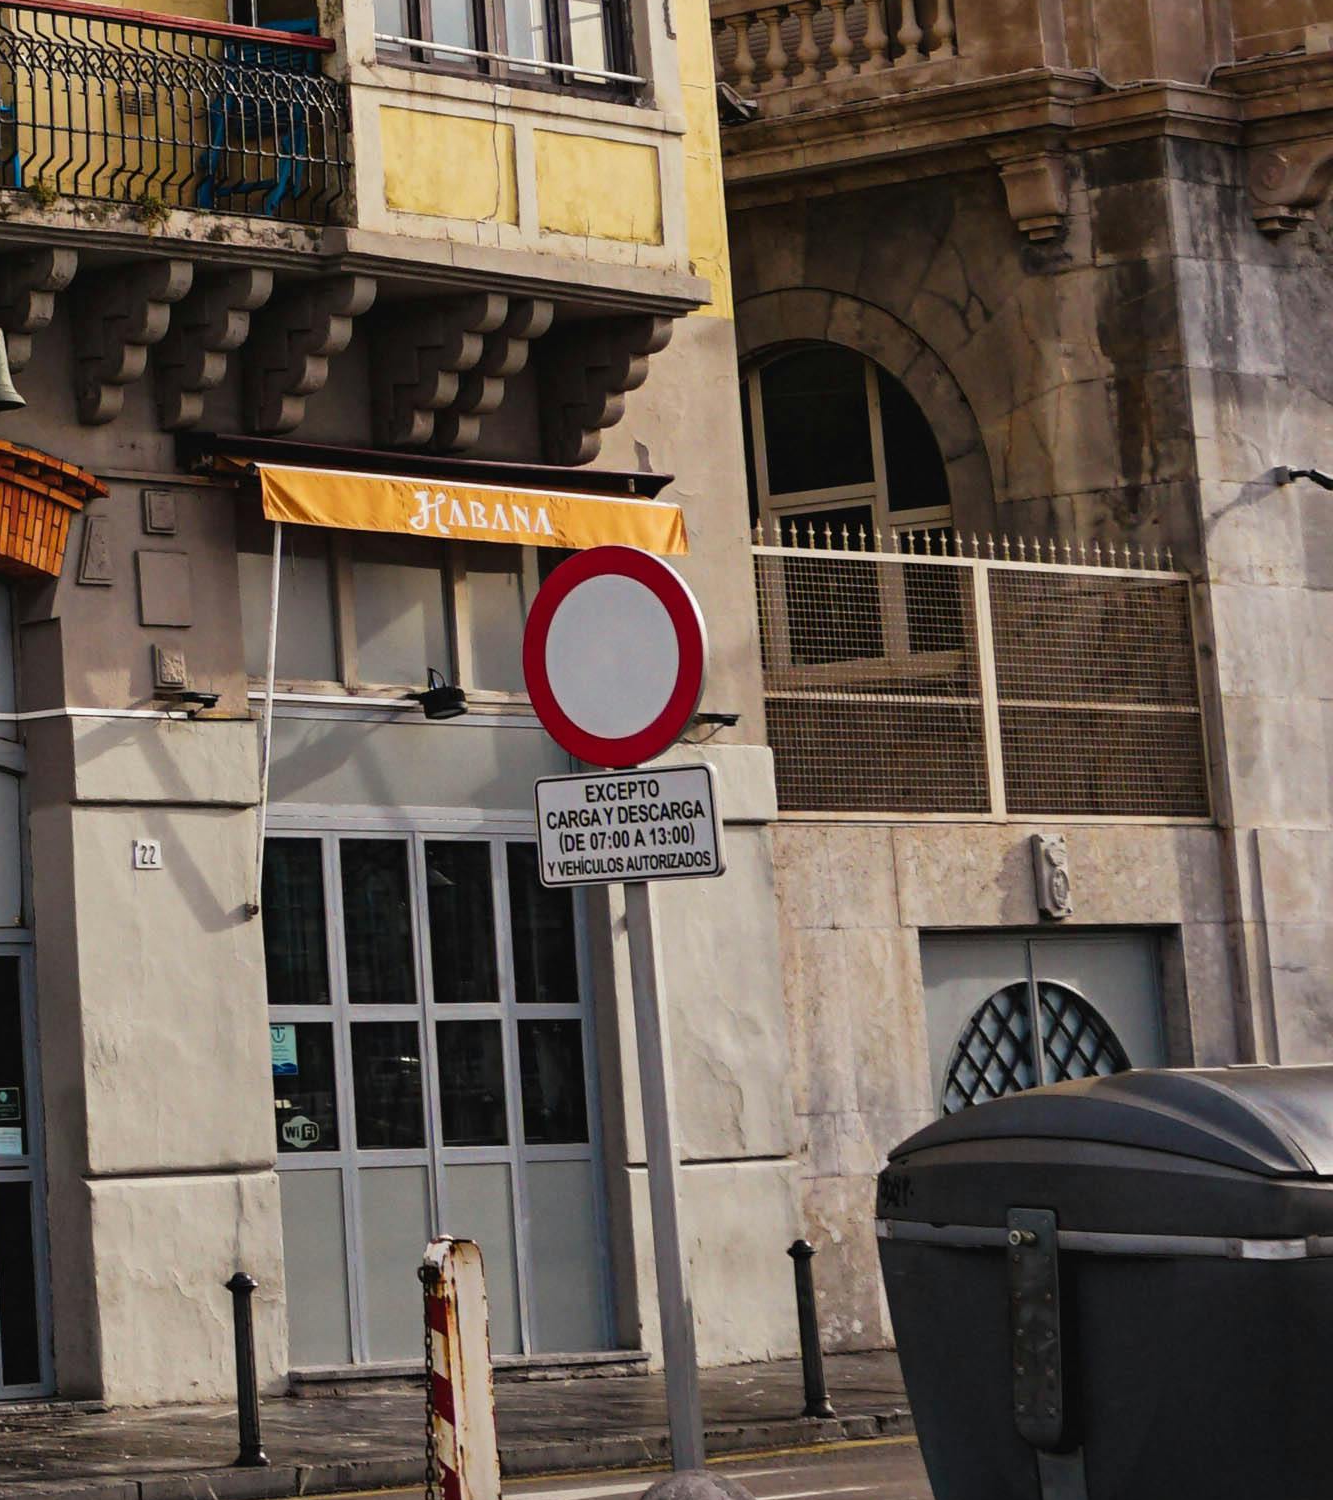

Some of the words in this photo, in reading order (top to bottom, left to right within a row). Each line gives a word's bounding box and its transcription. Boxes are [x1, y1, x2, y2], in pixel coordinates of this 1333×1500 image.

[409, 490, 554, 536] HABANA
[585, 779, 660, 803] EXCEPTO
[546, 809, 601, 830] CARGA
[602, 807, 614, 825] Y
[617, 800, 706, 825] DESCARGA
[559, 832, 586, 855] (DE
[589, 830, 630, 851] 07:00
[634, 828, 646, 847] A
[649, 823, 695, 846] 13:00)
[140, 844, 157, 865] 22
[547, 861, 556, 877] Y
[557, 856, 624, 877] VEHÍCULOS
[626, 850, 711, 872] AUTORIZADOS
